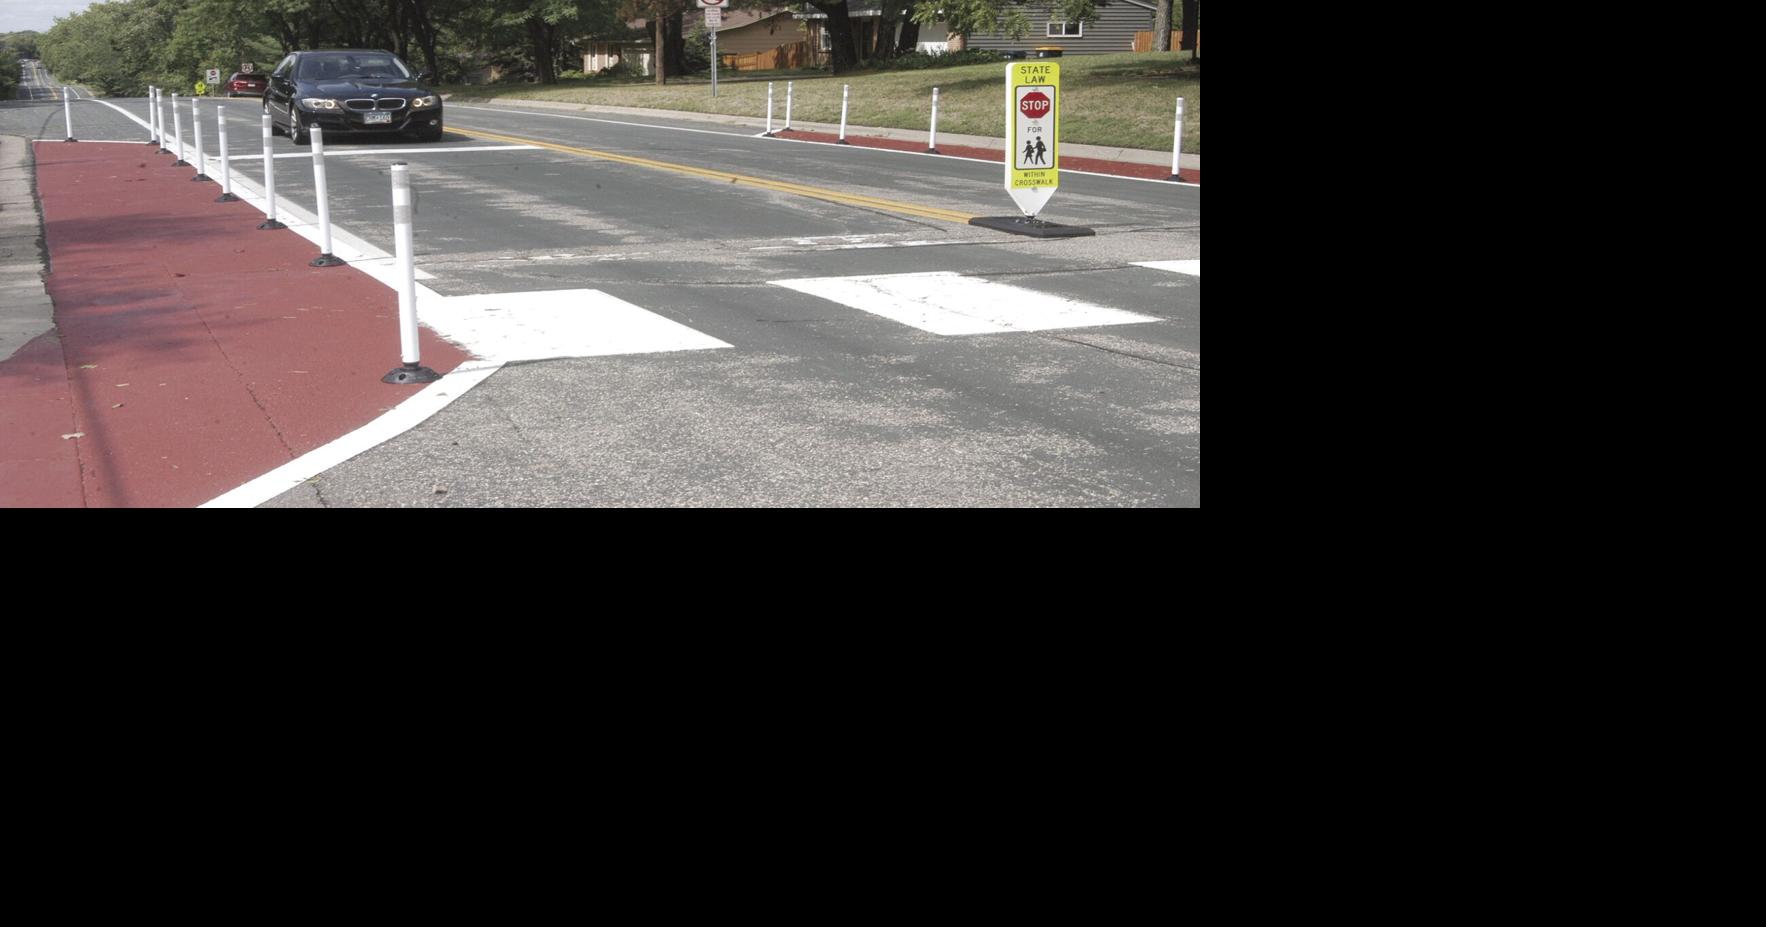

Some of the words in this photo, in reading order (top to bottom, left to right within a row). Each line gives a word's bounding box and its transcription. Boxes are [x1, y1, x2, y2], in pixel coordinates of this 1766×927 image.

[1020, 66, 1051, 74] STATE
[1025, 76, 1045, 84] LAW
[1022, 100, 1049, 111] STOP
[1014, 179, 1053, 187] CROSSWALK
